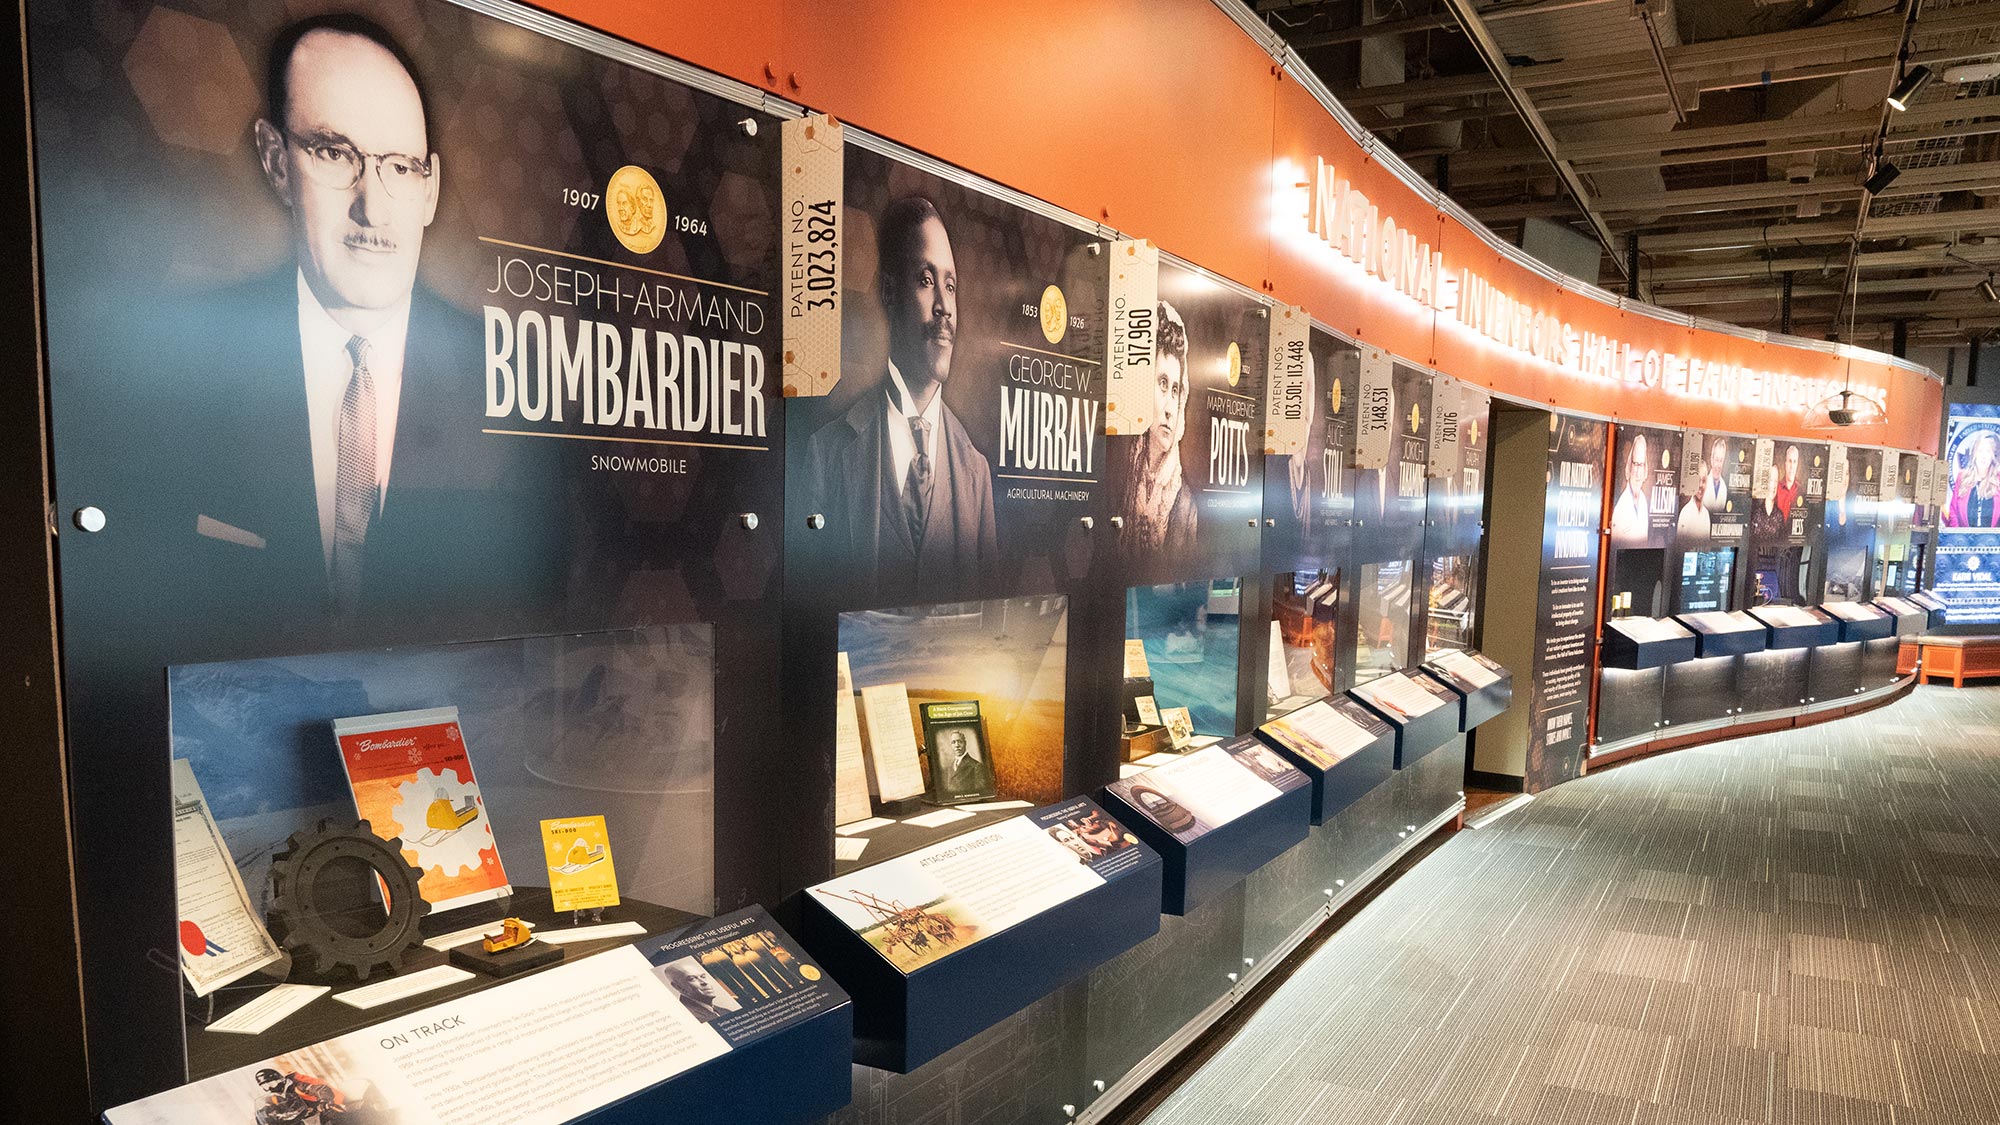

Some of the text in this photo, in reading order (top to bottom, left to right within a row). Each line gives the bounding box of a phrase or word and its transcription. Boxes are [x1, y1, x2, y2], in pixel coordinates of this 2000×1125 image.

[562, 188, 599, 211] 1907
[674, 215, 707, 237] 1964
[791, 195, 804, 318] PATENT NO.
[807, 199, 837, 311] 3,023,824
[487, 256, 764, 335] JOSEPH-ARMAND
[1308, 155, 1443, 311] NATIONAL
[1456, 268, 1572, 365] INVENTORS
[1579, 331, 1634, 381] HALL
[1642, 350, 1675, 389] OF
[1685, 358, 1753, 406] FAME
[1022, 304, 1038, 318] 1853
[1070, 316, 1085, 329] 1926
[1113, 294, 1126, 379] PATENT NO.
[1128, 308, 1154, 366] 517,960
[483, 305, 767, 437] BOMBARDIER
[1009, 354, 1093, 394] GEORGE W.
[1287, 340, 1304, 378] 113,448
[1272, 343, 1284, 415] PATENT NOS.
[1206, 396, 1256, 419] MARY FLORENCE
[1361, 382, 1372, 436] PATENT NO.
[1371, 387, 1388, 431] 3,148,531
[999, 385, 1099, 473] MURRAY
[1434, 419, 1442, 449] PATENT
[1443, 412, 1458, 443] 730,176
[591, 455, 687, 474] SNOWMOBILE
[1209, 416, 1250, 487] POTTS
[1007, 488, 1090, 501] AGRICULTURAL MACHINERY
[1650, 486, 1677, 514] ALLISON
[919, 849, 957, 867] ATTACHED
[967, 833, 1004, 849] INVENTION
[660, 917, 755, 952] PROGRESSING THE USEFUL ARTS
[380, 1014, 466, 1050] ON TRACK
